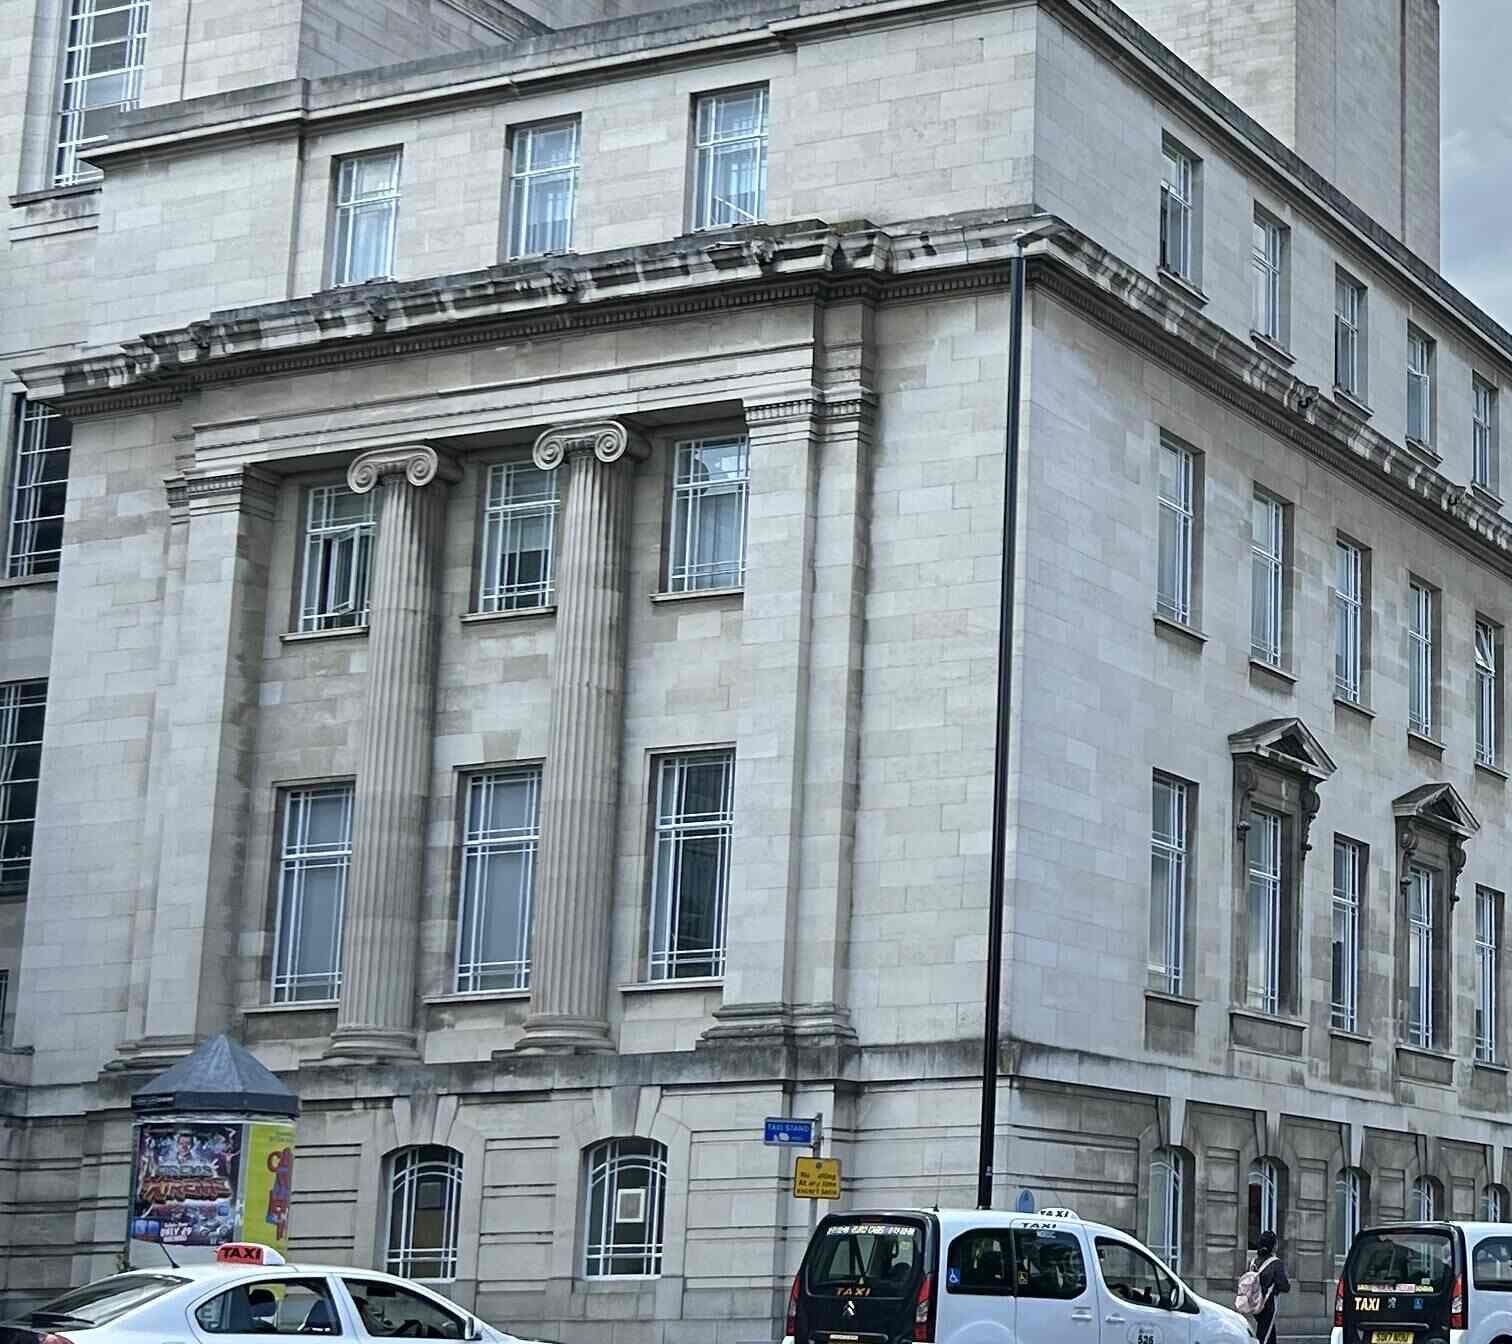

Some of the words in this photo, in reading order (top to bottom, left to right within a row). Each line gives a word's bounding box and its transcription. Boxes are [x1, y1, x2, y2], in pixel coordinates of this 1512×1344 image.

[1040, 1210, 1070, 1218] TAXI
[220, 1246, 262, 1260] TAXI
[836, 1287, 871, 1296] TAXI
[1354, 1297, 1380, 1311] TAXI
